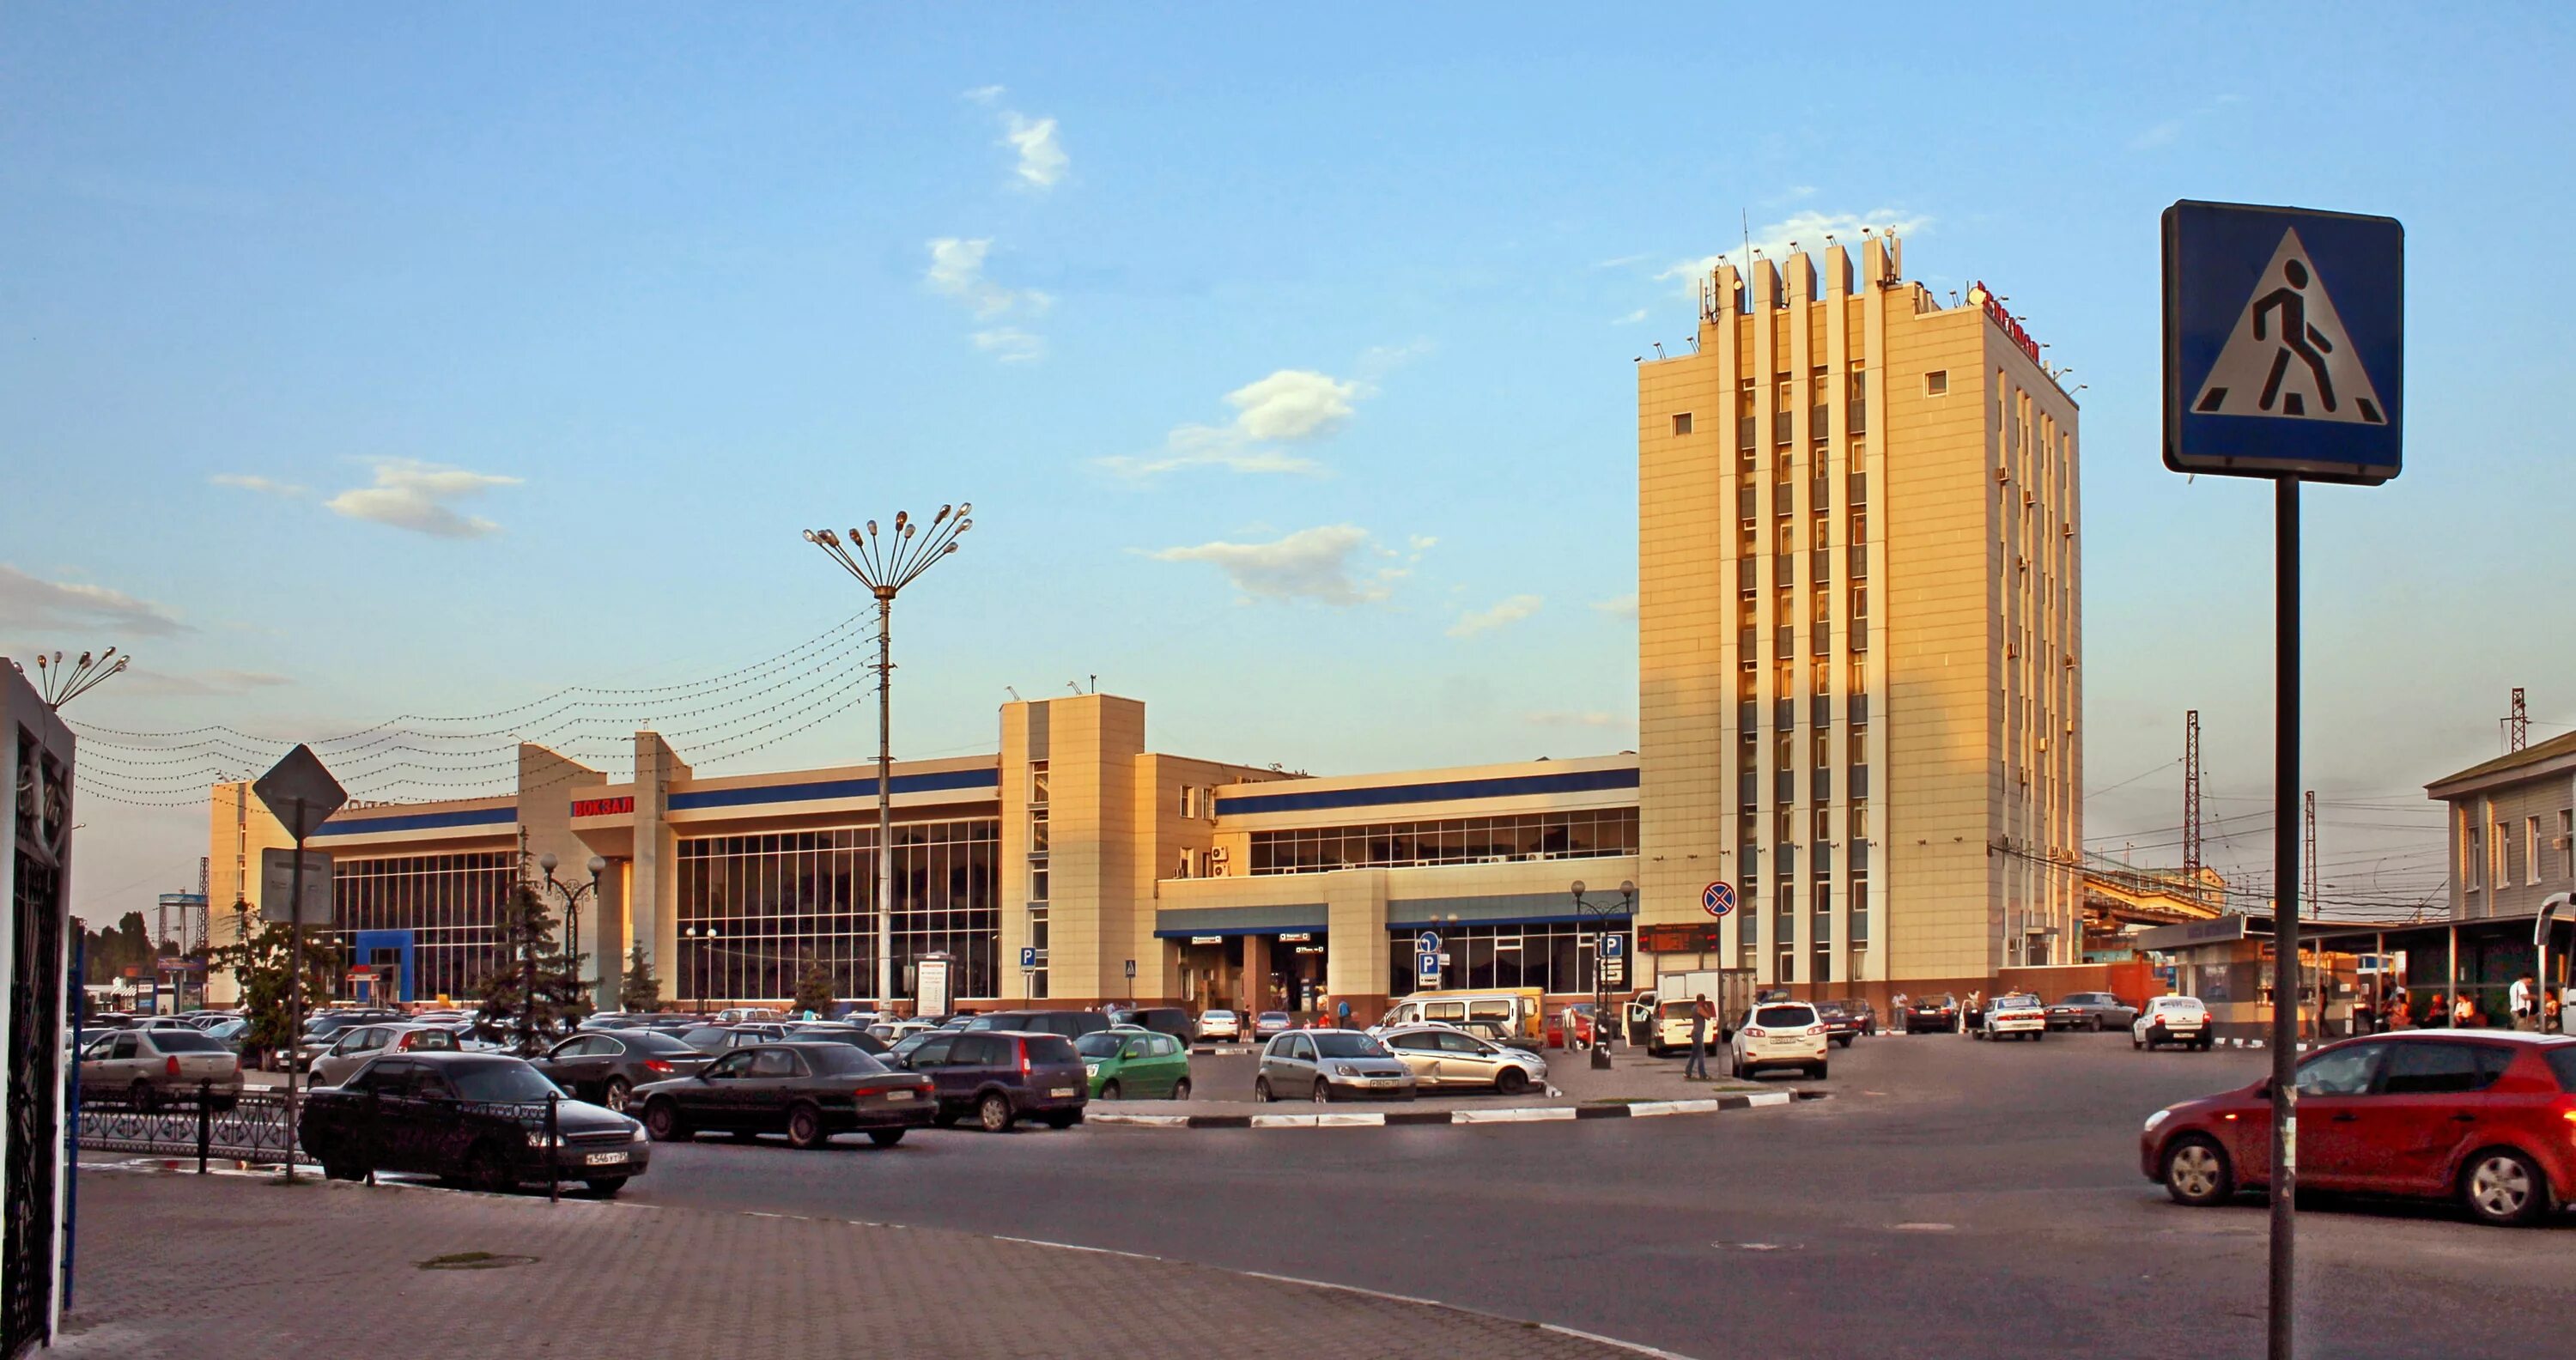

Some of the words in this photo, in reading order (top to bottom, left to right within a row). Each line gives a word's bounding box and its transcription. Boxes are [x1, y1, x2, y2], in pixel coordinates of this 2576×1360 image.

[573, 798, 634, 817] ВОКЗАЛ
[1607, 938, 1617, 954] P
[1024, 950, 1032, 963] P
[1424, 956, 1434, 972] P
